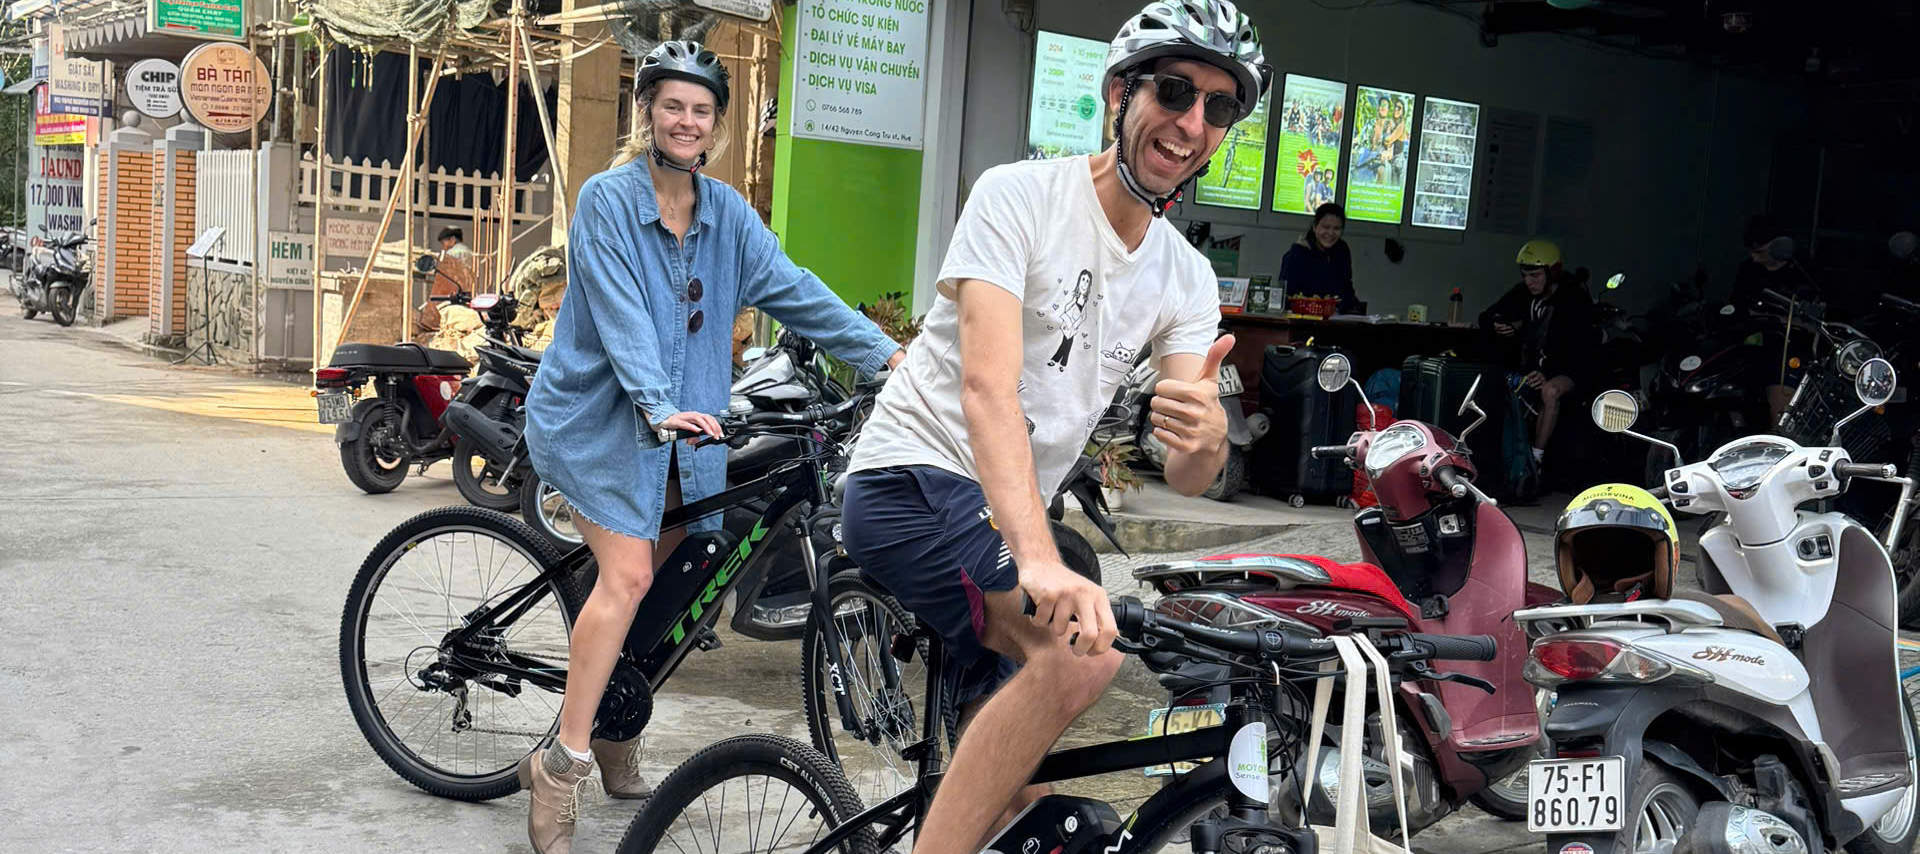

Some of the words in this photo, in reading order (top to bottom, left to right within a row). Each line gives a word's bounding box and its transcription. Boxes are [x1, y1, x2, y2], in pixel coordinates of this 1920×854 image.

[828, 8, 859, 25] CHỨC
[861, 14, 875, 31] SỰ
[877, 16, 900, 34] KIỆN
[810, 28, 829, 46] ĐẠI
[832, 28, 844, 45] LÝ
[846, 32, 859, 48] VÉ
[862, 35, 884, 52] MÁY
[887, 41, 906, 55] BAY
[141, 71, 176, 83] CHIP
[810, 51, 836, 68] DỊCH
[840, 56, 853, 73] VỤ
[856, 56, 877, 75] VẬN
[880, 60, 920, 79] CHUYỂN
[808, 73, 835, 90] DỊCH
[838, 77, 852, 95] VỤ
[855, 80, 877, 95] VISA
[664, 515, 769, 646] TREK
[1334, 607, 1371, 619] mode
[1731, 654, 1766, 666] mode
[827, 662, 846, 696] XCT
[780, 757, 800, 773] CST
[1543, 763, 1606, 795] 75-F1
[1534, 796, 1618, 828] 860.79
